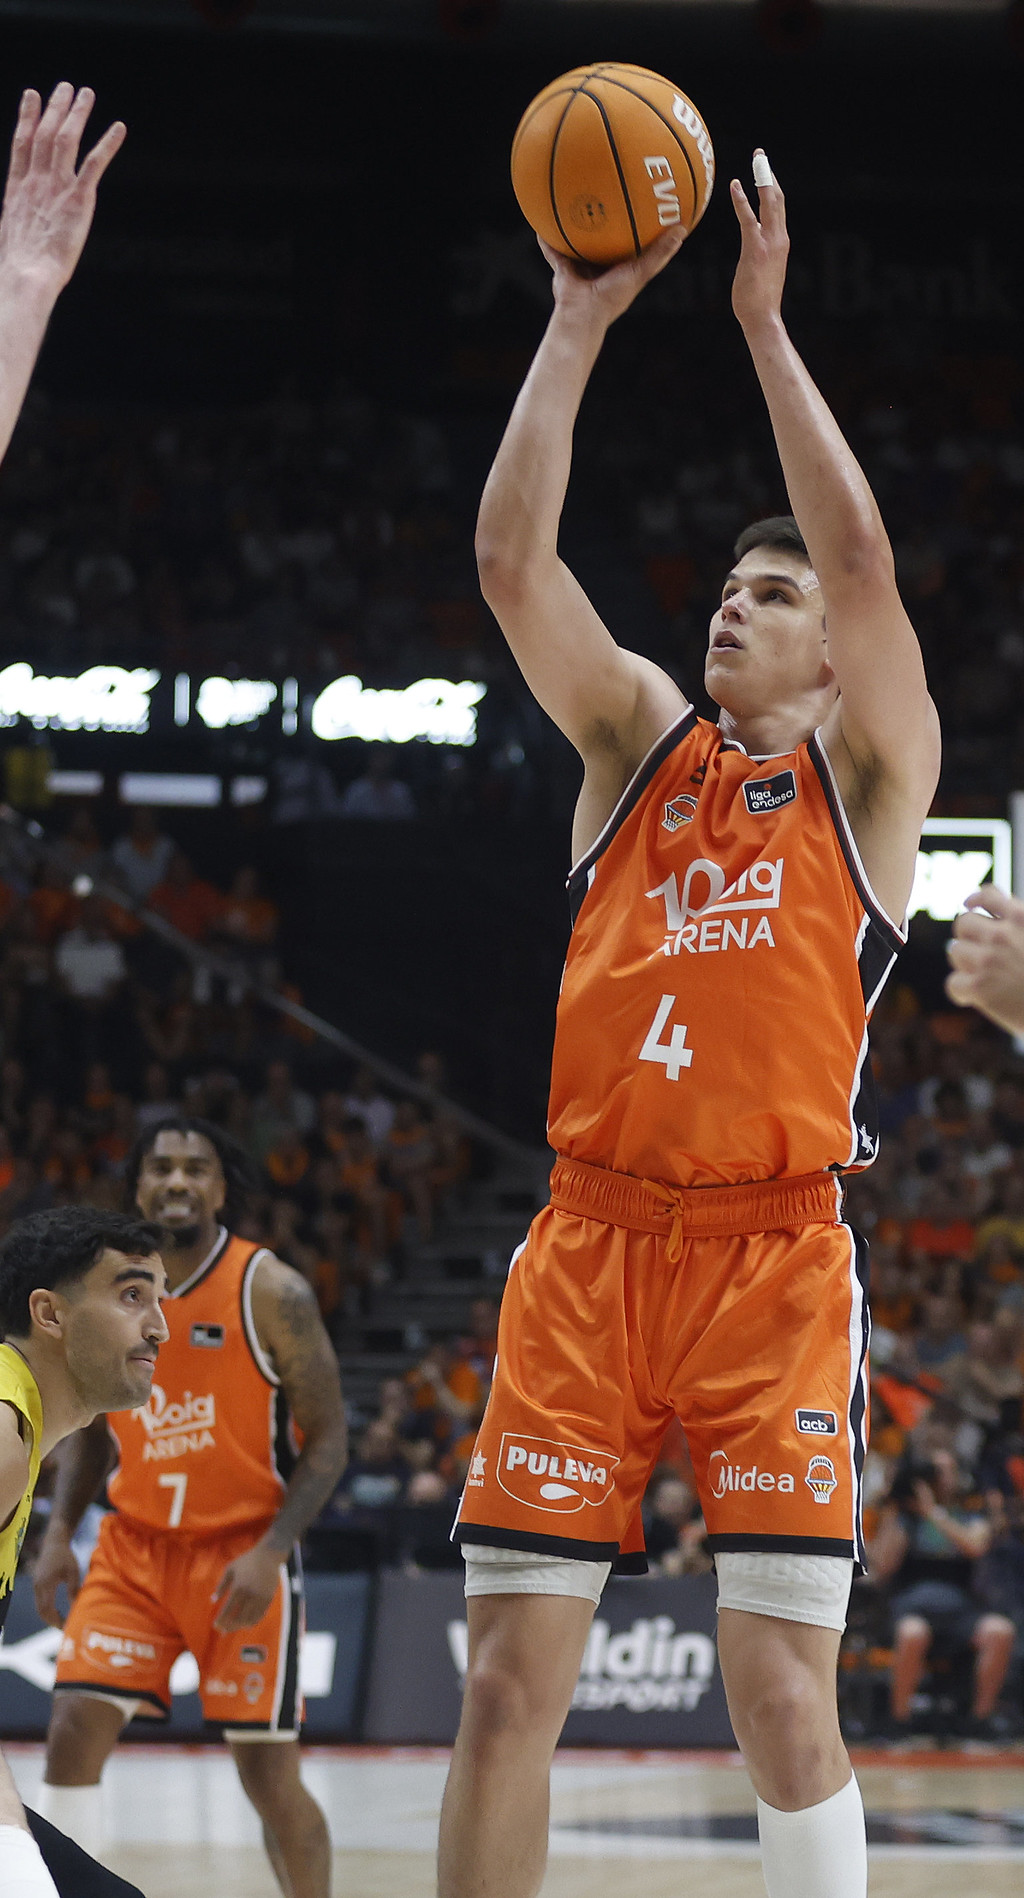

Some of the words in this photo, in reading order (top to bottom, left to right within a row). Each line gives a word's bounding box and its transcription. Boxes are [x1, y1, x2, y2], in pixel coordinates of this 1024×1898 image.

[749, 789, 771, 801] liga
[752, 789, 793, 809] endesa
[638, 994, 693, 1081] 4
[800, 1419, 828, 1432] acb
[506, 1445, 607, 1485] PULEVA
[712, 1459, 794, 1496] Midea
[159, 1473, 188, 1528] 7
